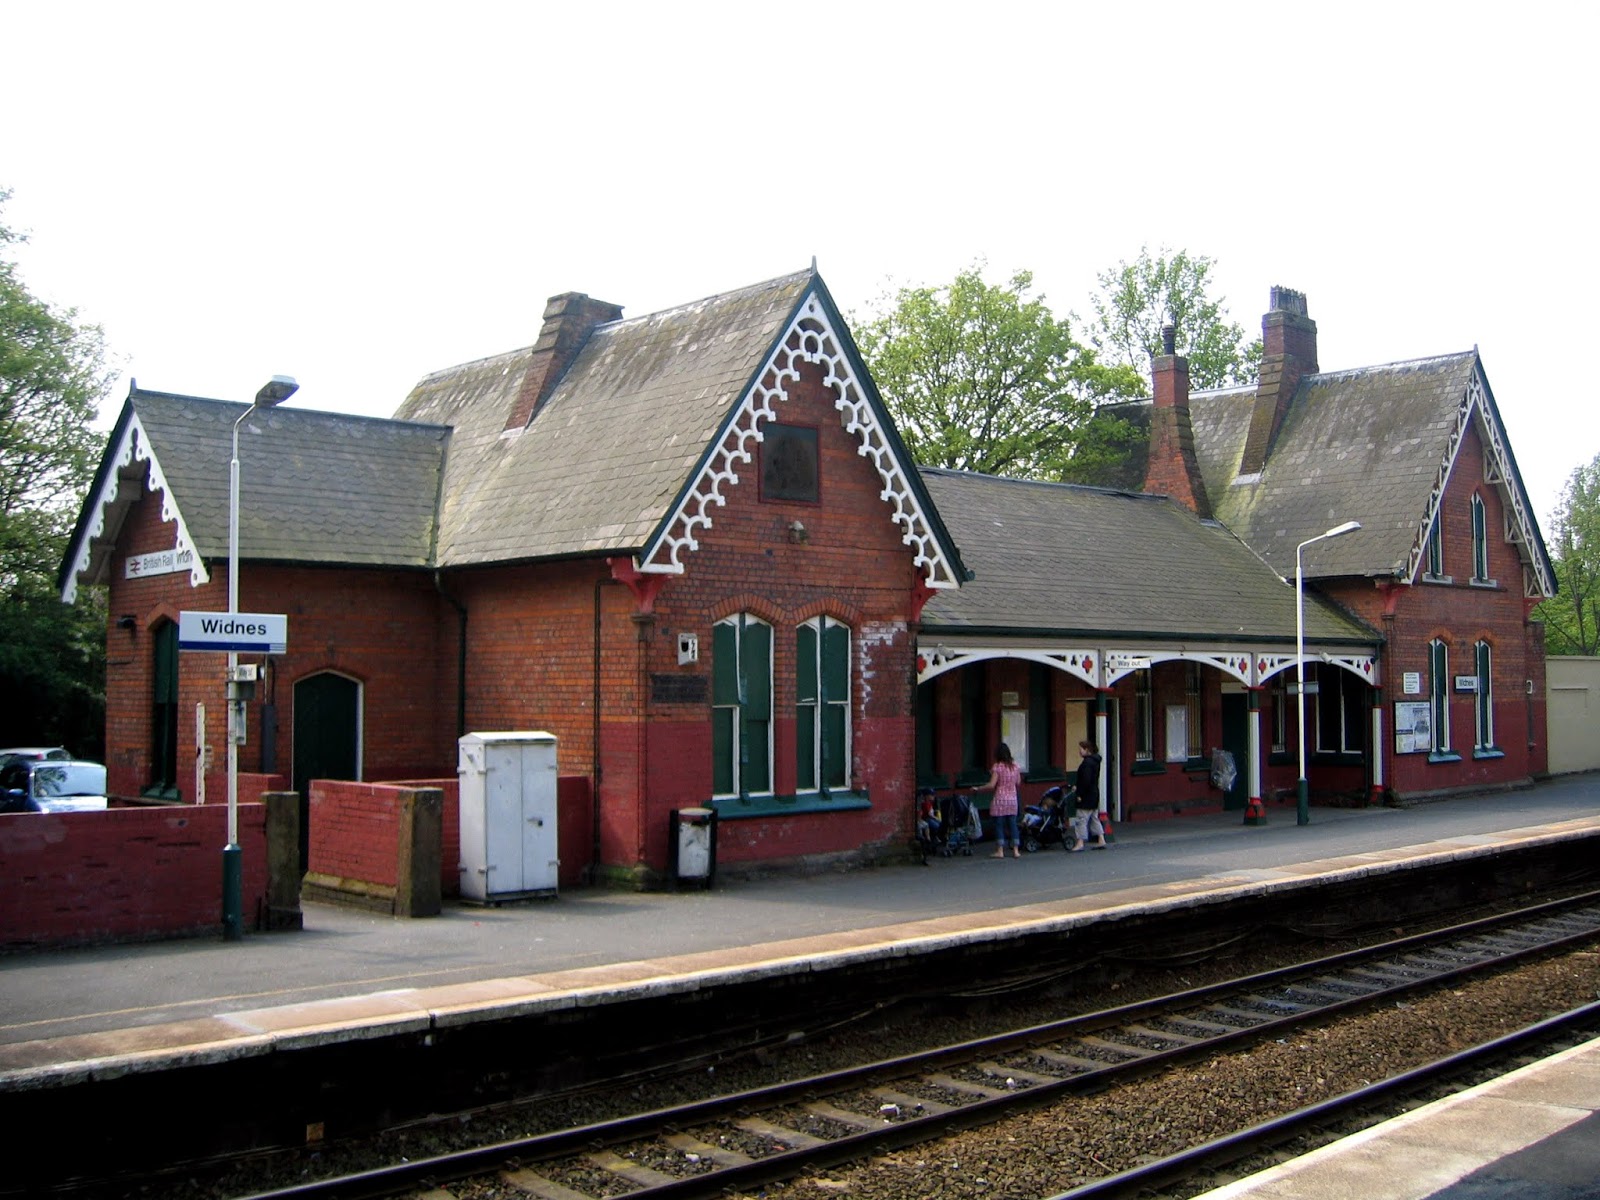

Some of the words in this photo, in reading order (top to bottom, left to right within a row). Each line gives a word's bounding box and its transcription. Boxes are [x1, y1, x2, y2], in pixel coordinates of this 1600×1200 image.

[143, 556, 161, 570] British
[162, 553, 174, 567] Rail
[201, 619, 267, 635] Widnes
